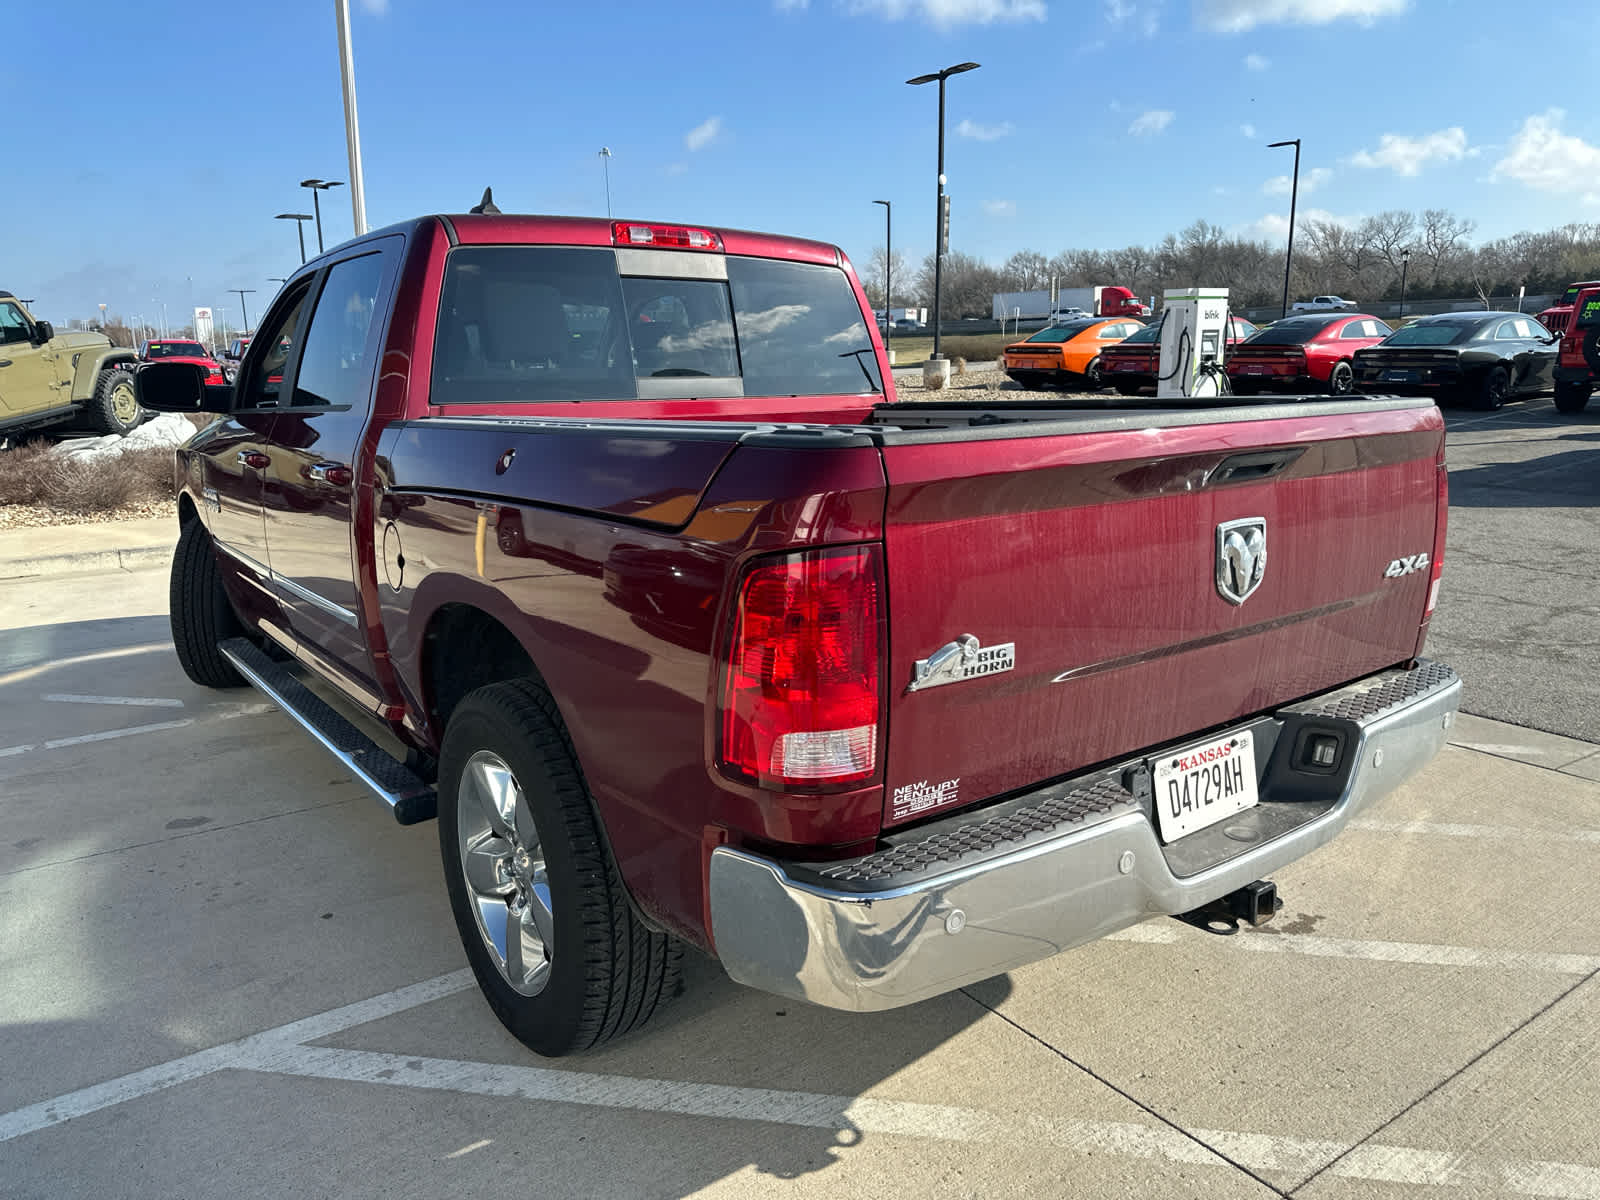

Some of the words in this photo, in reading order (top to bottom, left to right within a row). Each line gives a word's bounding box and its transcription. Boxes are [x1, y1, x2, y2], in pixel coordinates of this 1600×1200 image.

[977, 649, 1007, 663] BIG
[963, 659, 1013, 677] HORN
[1179, 743, 1232, 772] KANSAS
[893, 778, 961, 804] CENTURY
[894, 780, 928, 796] NEW
